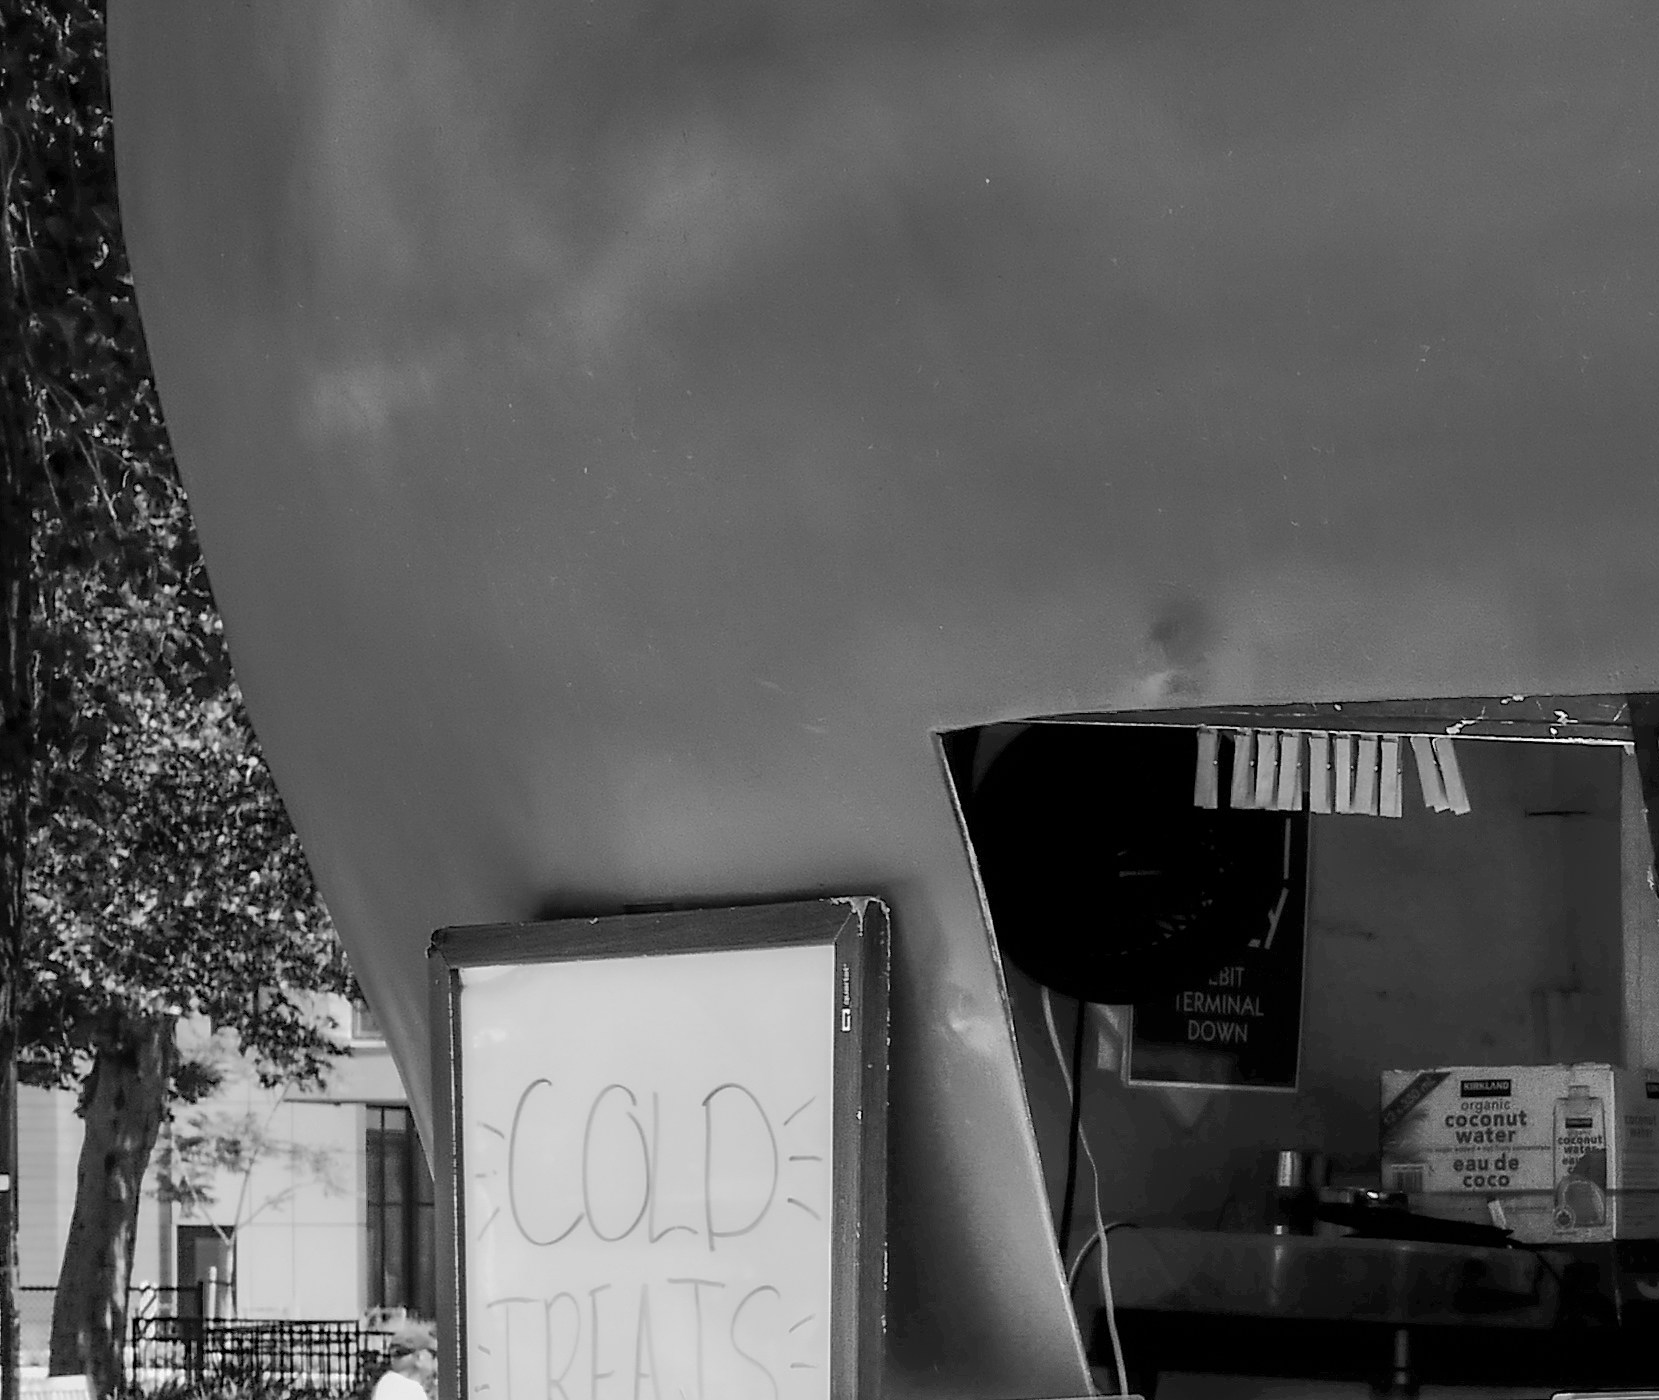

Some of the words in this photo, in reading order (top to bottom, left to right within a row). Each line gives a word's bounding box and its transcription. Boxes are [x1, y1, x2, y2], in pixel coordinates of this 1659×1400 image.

[1188, 1020, 1247, 1043] DOWN
[1462, 1099, 1511, 1111] organic
[1445, 1109, 1527, 1127] coconut
[1456, 1128, 1516, 1144] water
[508, 1078, 778, 1253] COLD
[1454, 1157, 1488, 1171] eau
[1495, 1153, 1520, 1171] de
[1463, 1173, 1510, 1187] coco
